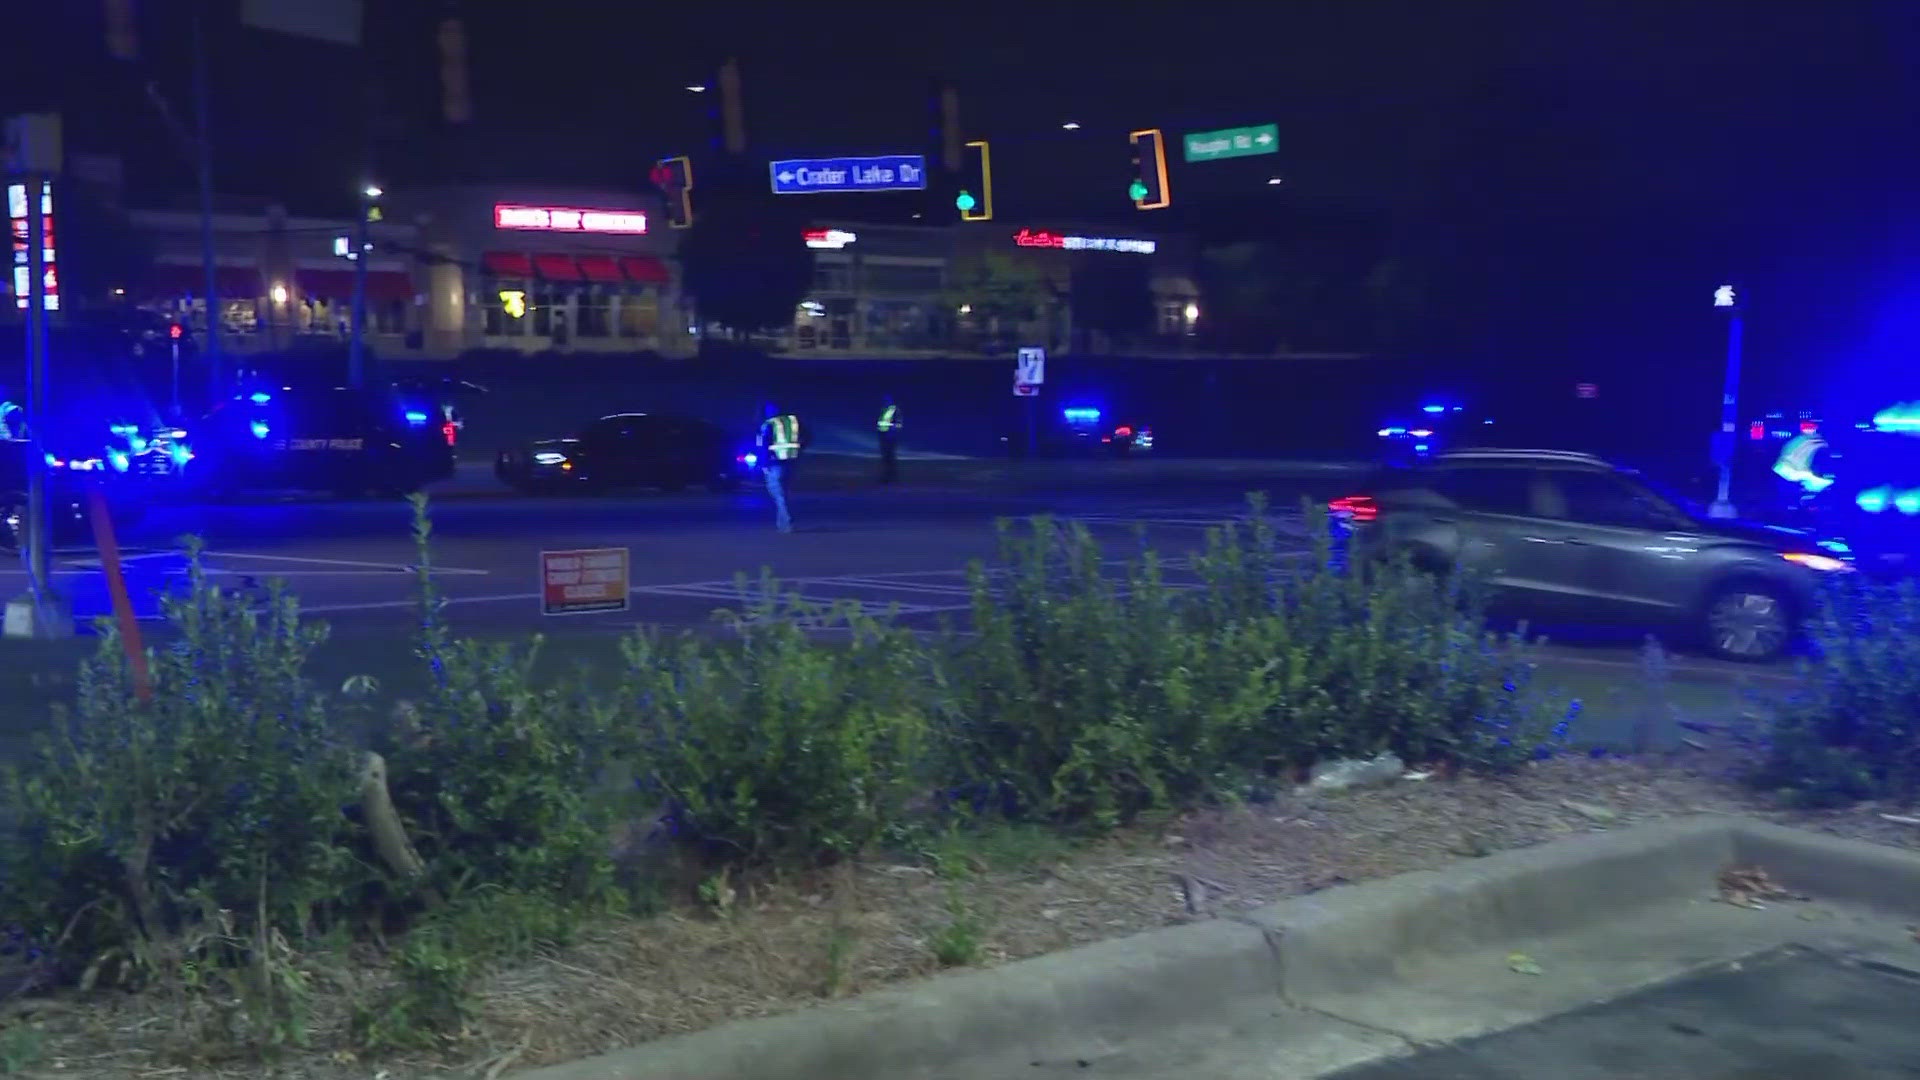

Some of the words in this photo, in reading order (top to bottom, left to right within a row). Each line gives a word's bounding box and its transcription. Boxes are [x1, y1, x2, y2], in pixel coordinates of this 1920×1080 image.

[796, 167, 846, 186] Crater
[852, 164, 894, 184] Lake
[899, 163, 920, 183] Dr
[289, 439, 328, 450] COUNTY
[329, 438, 363, 450] POLICE
